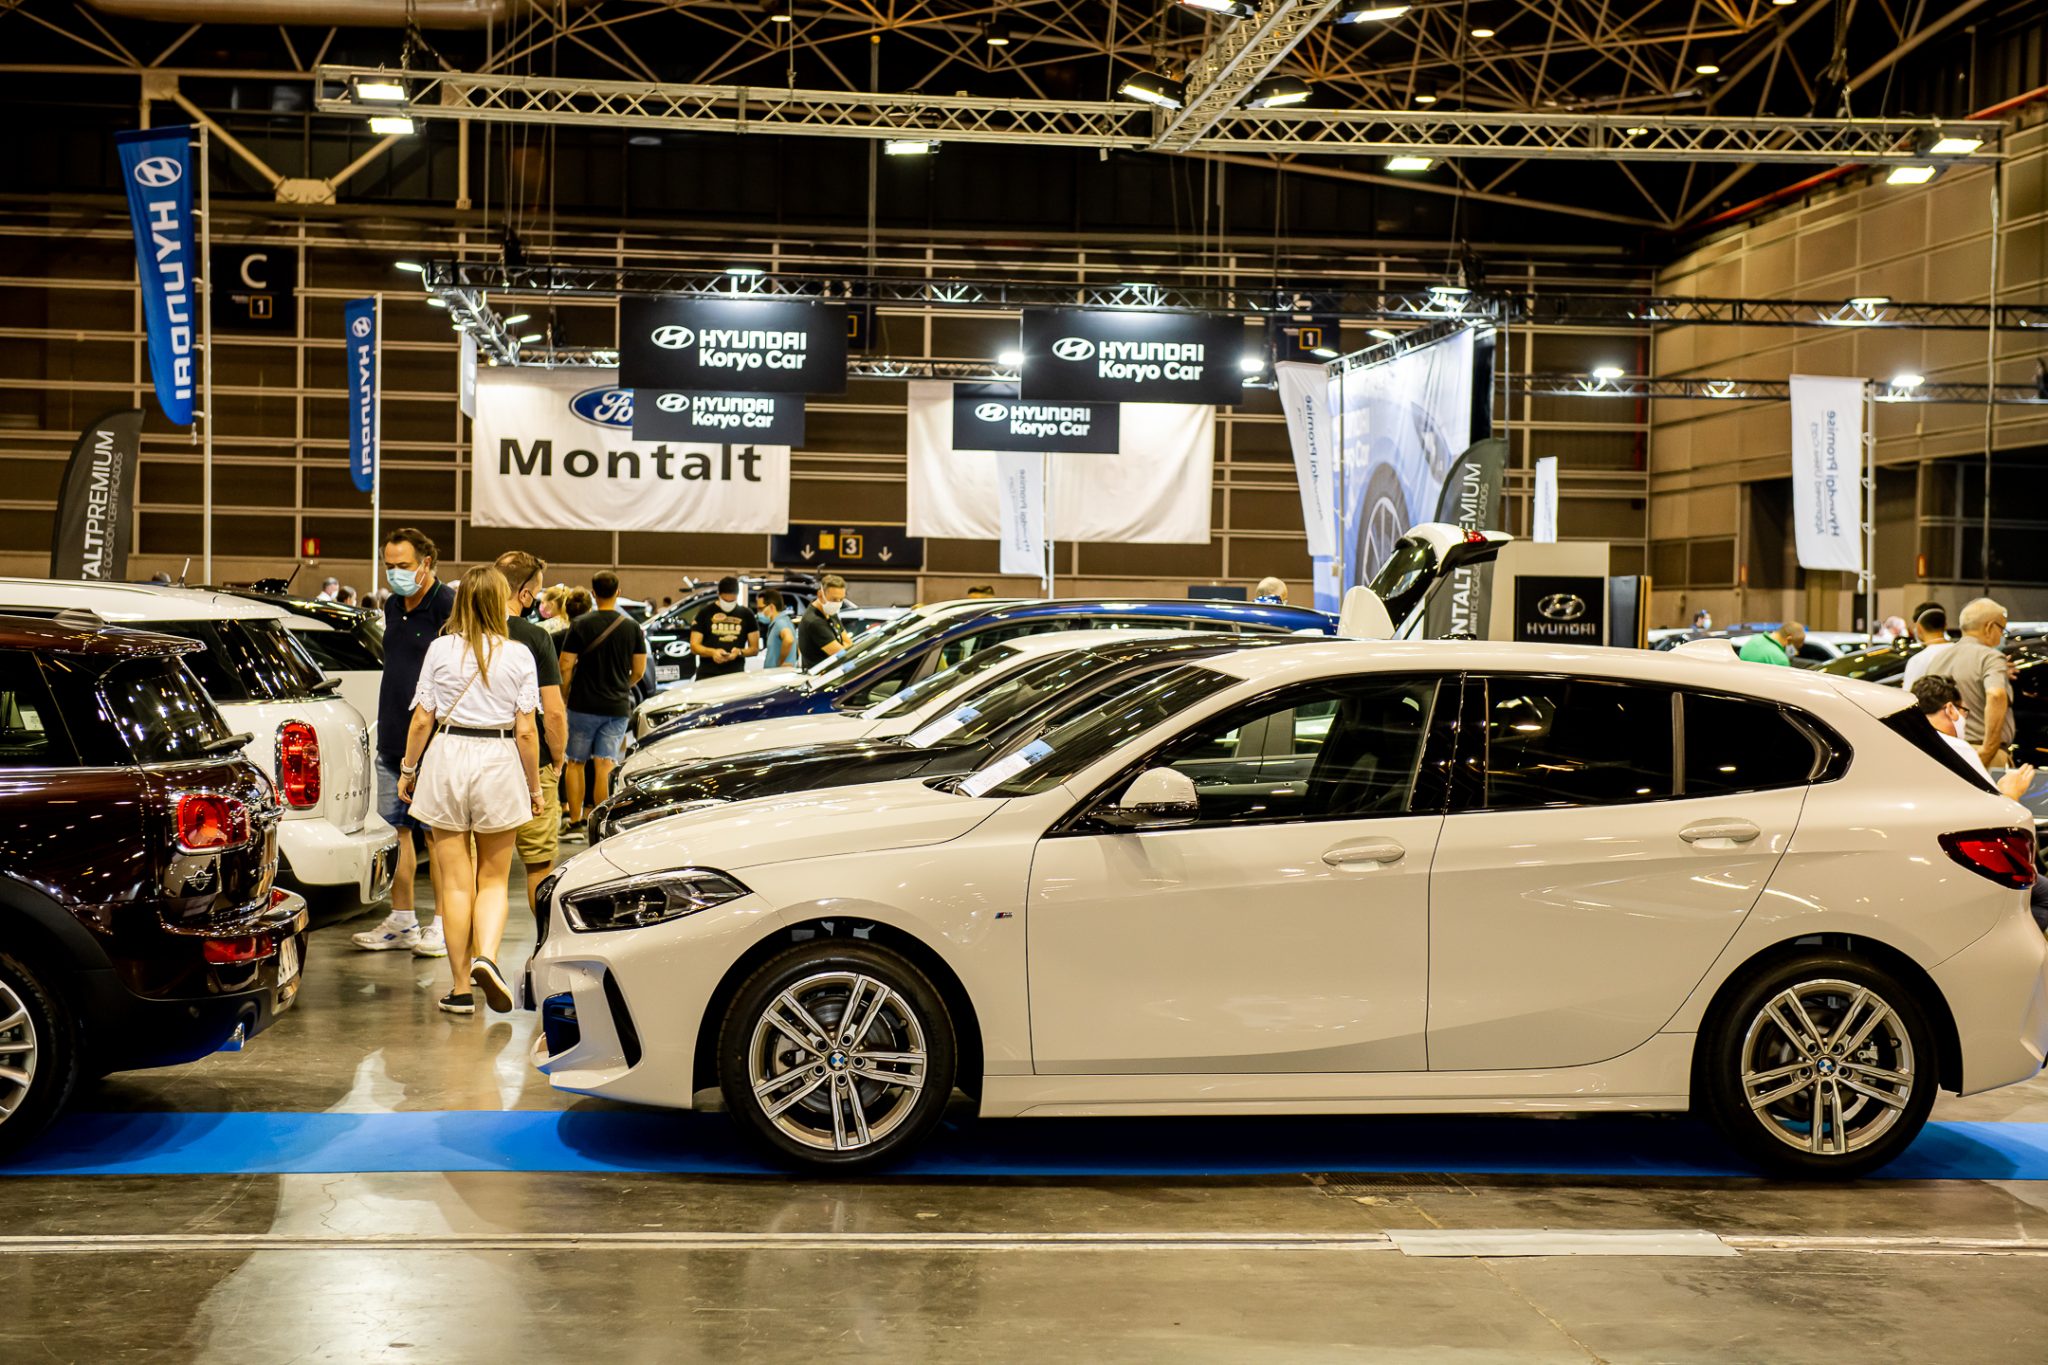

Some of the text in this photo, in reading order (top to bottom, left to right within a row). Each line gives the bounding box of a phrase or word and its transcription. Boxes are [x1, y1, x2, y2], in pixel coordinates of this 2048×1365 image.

[240, 253, 268, 289] C
[149, 200, 191, 400] HYUNDAI
[698, 328, 807, 350] HYUNDAI
[1306, 331, 1314, 346] 1
[698, 348, 807, 371] Koryo Car
[1099, 341, 1205, 362] HYUNDAI
[1098, 359, 1204, 383] Koryo Car
[357, 344, 373, 476] HYUNDAI
[593, 390, 635, 423] Fo
[692, 395, 775, 413] HYUNDAI
[1010, 405, 1091, 422] HYUNDAI
[692, 410, 775, 430] Koryo Car
[1009, 420, 1091, 438] Koryo Car
[499, 438, 762, 483] Montalt
[107, 451, 124, 522] CERTIFICADOS
[81, 429, 116, 580] ALTPREMIUM
[844, 537, 858, 555] 3
[1526, 622, 1596, 636] HYUNDAI
